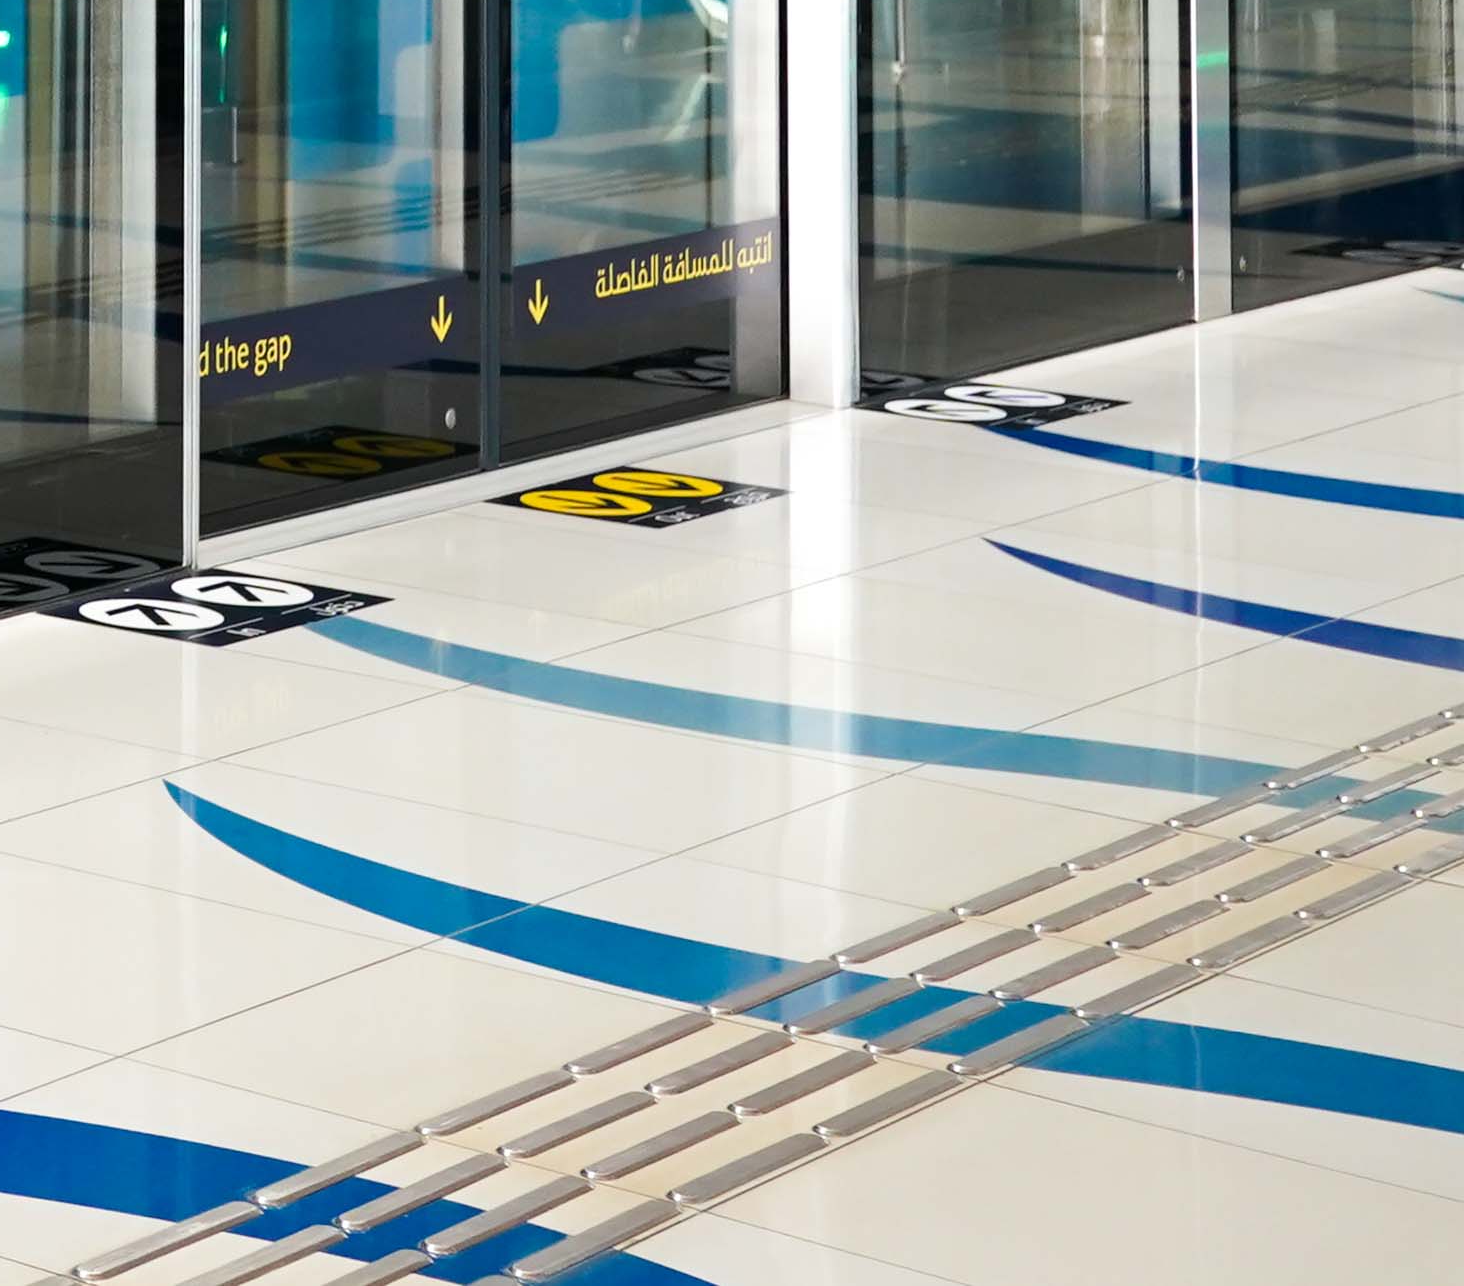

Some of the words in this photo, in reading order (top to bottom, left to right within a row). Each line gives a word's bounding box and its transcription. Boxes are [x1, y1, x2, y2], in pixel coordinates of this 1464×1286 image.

[594, 255, 659, 301] الفاصلة
[661, 237, 734, 285] للمسافة
[735, 234, 773, 277] انتبه
[214, 337, 250, 373] the
[254, 332, 293, 382] gap
